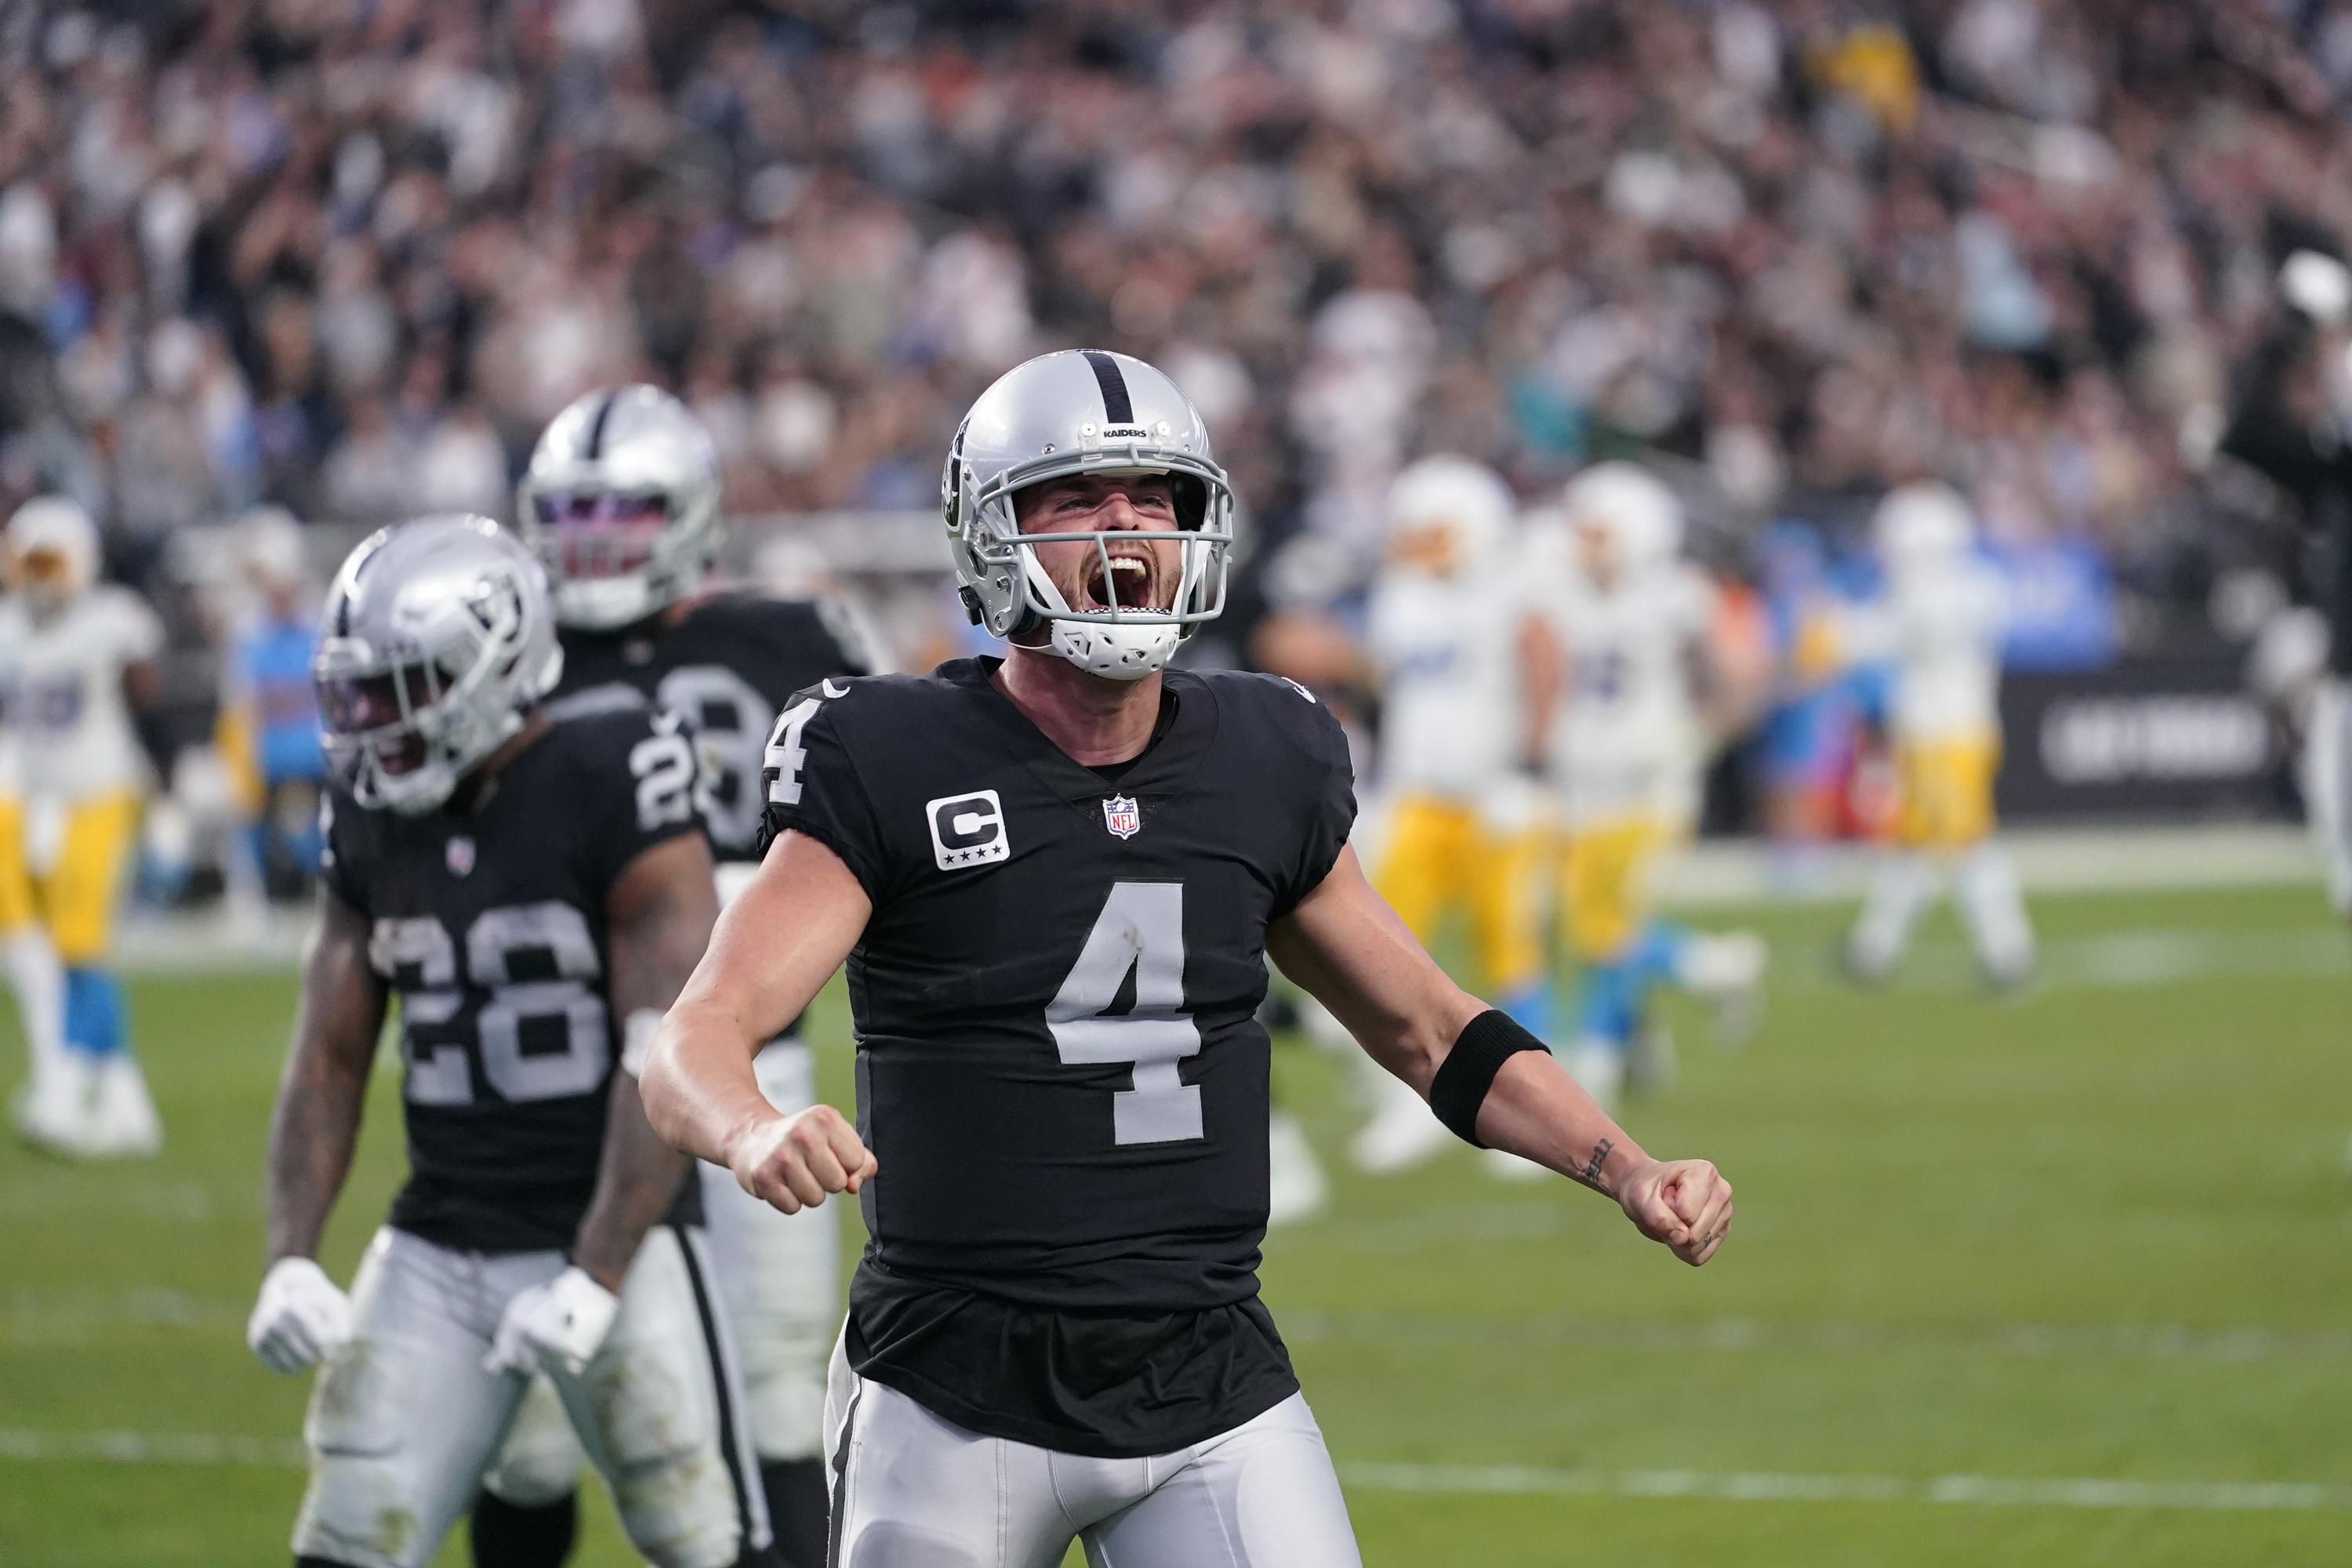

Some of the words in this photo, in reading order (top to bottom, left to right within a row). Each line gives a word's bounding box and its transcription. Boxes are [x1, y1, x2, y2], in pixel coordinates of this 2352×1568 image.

[1103, 429, 1147, 437] RAIDERS
[763, 699, 822, 805] 4
[935, 797, 999, 851] C
[1112, 814, 1135, 831] NFL
[368, 900, 610, 1105] 28
[1045, 882, 1203, 1145] 4
